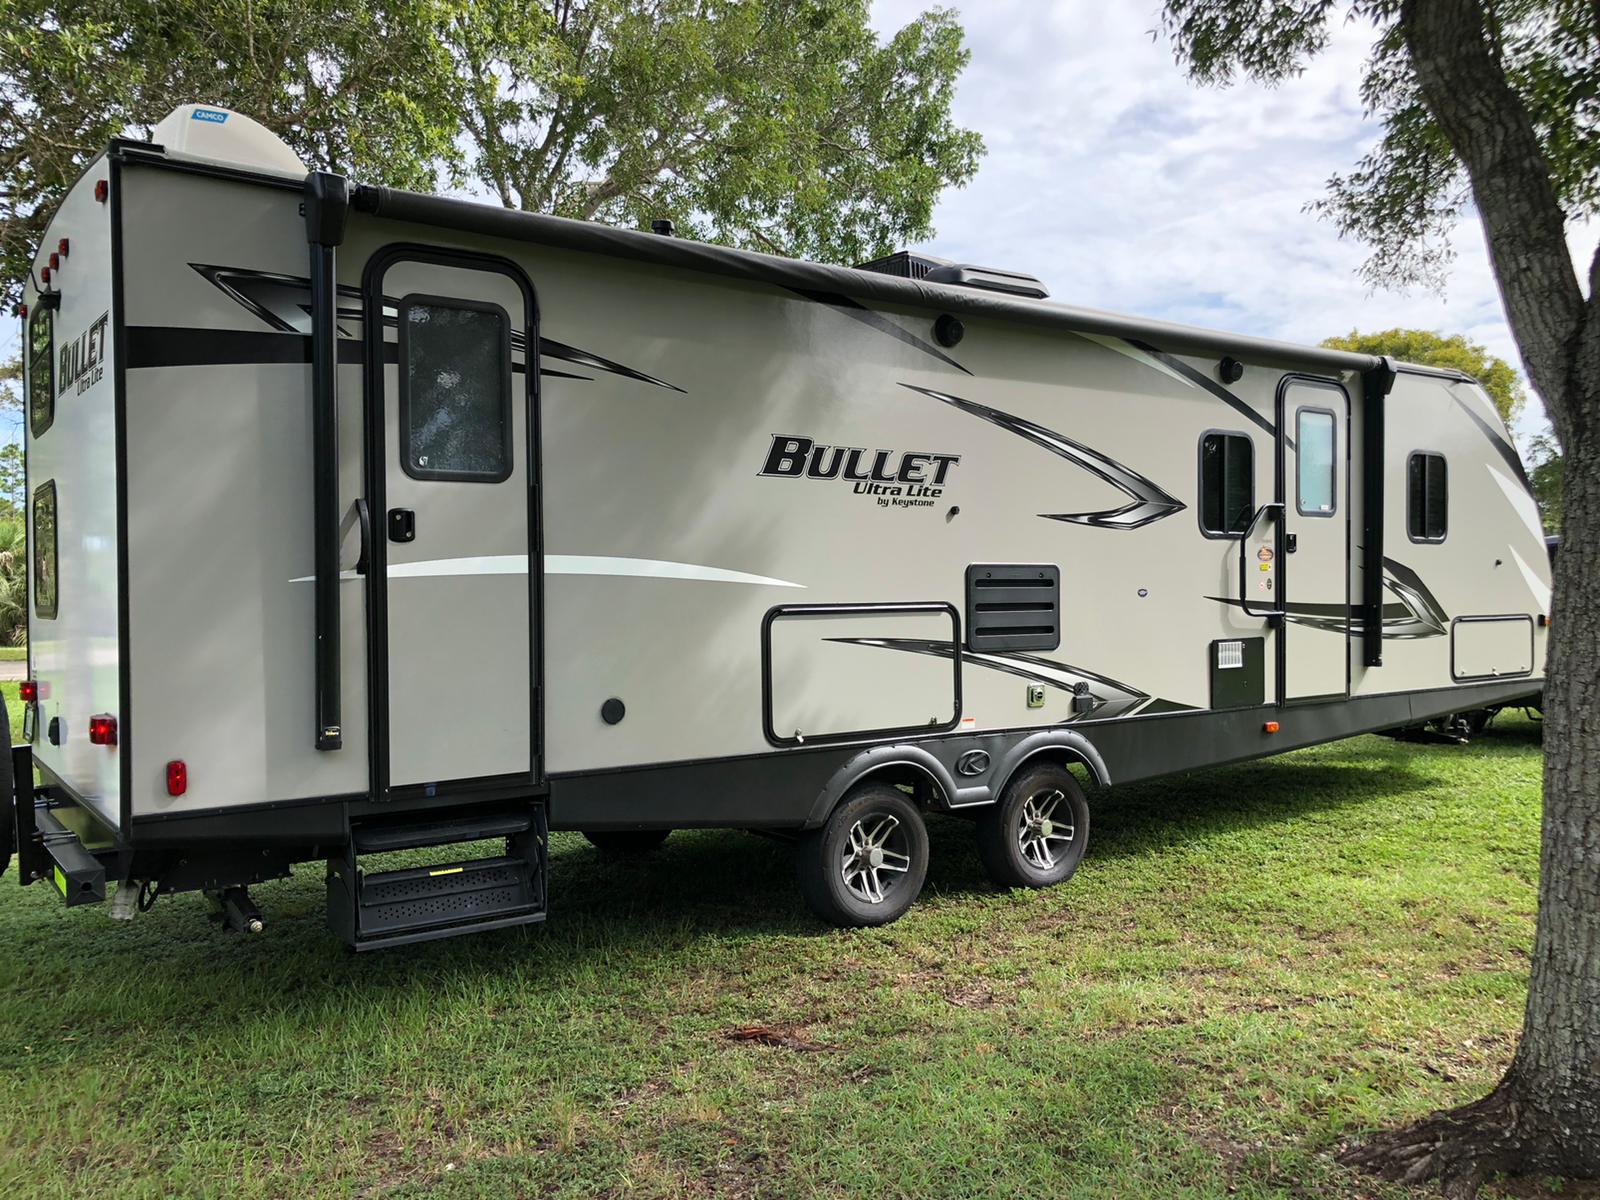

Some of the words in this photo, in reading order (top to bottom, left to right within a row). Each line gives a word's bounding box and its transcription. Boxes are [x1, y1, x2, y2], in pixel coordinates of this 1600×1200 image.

[195, 111, 224, 121] CAMCO
[58, 310, 109, 398] BULLET
[77, 377, 90, 396] Ultra
[91, 367, 103, 386] Lite
[756, 433, 962, 486] BULLET
[853, 482, 902, 496] Ultra
[906, 485, 943, 498] Lite
[877, 497, 890, 507] by
[892, 498, 935, 508] Keystone
